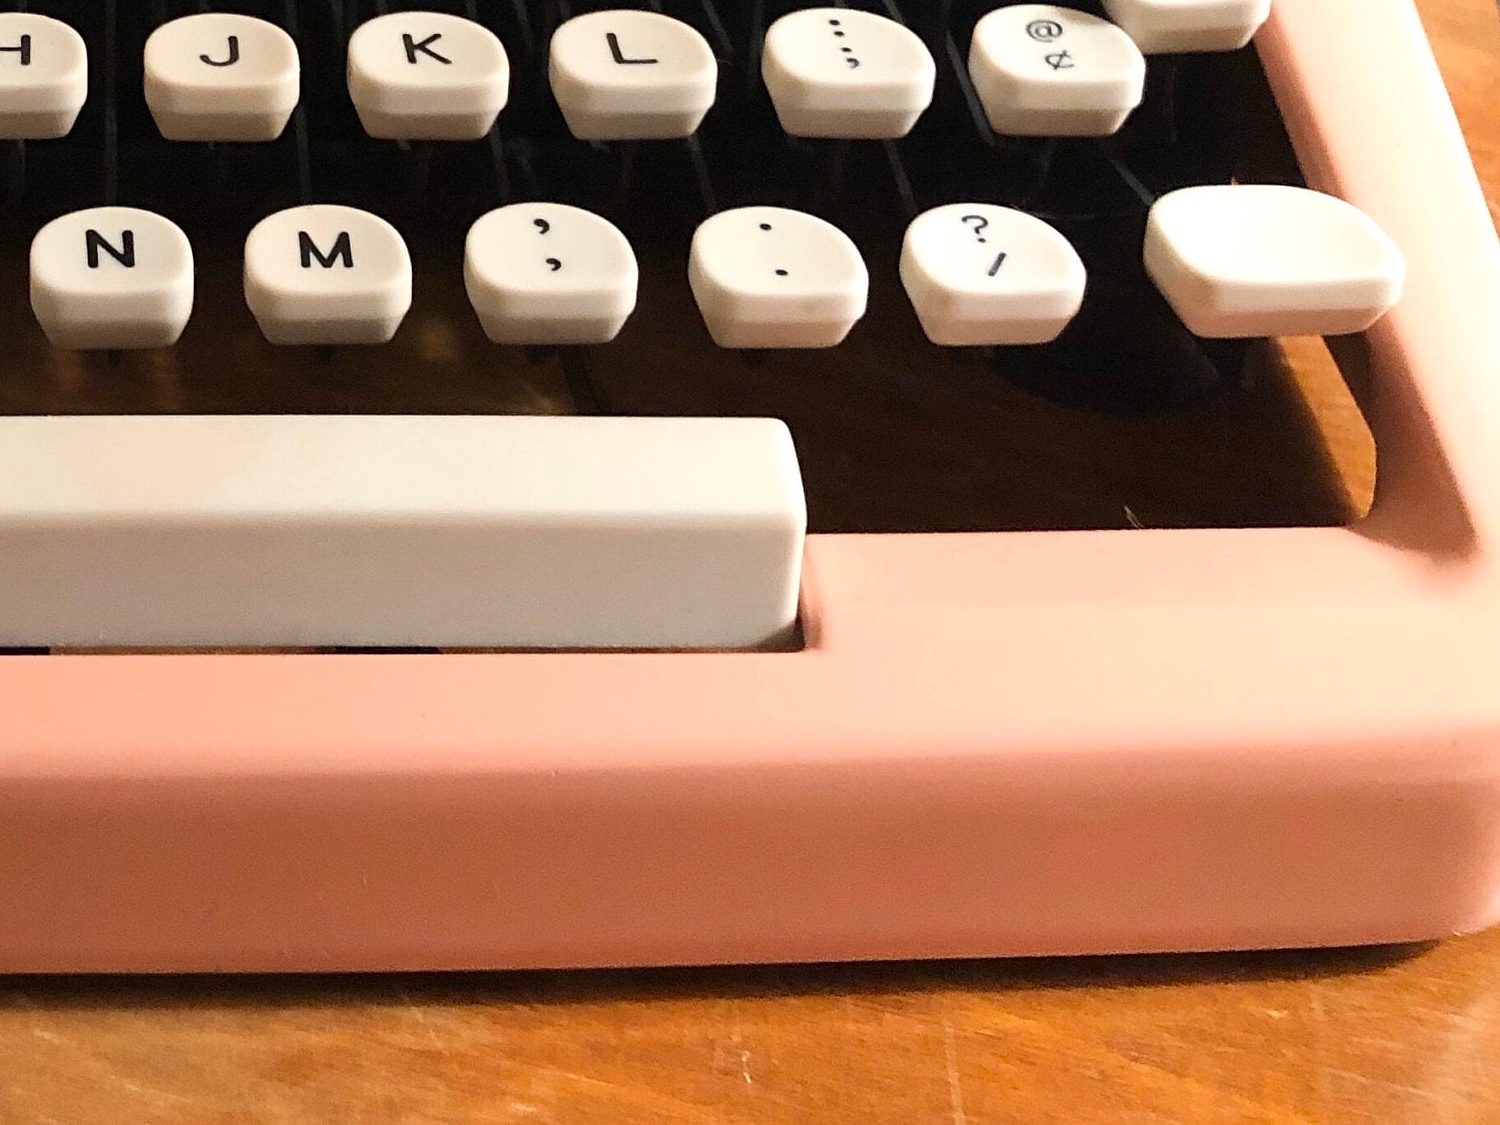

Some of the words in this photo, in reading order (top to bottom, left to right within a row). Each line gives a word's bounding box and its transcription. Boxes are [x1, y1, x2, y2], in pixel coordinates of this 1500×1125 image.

[1025, 19, 1064, 43] @
[199, 35, 240, 68] J
[401, 33, 453, 65] K
[605, 32, 659, 65] L
[1044, 49, 1075, 71] ¢
[961, 214, 989, 244] ?
[85, 228, 136, 269] N
[297, 230, 354, 269] M
[987, 252, 1007, 277] /
